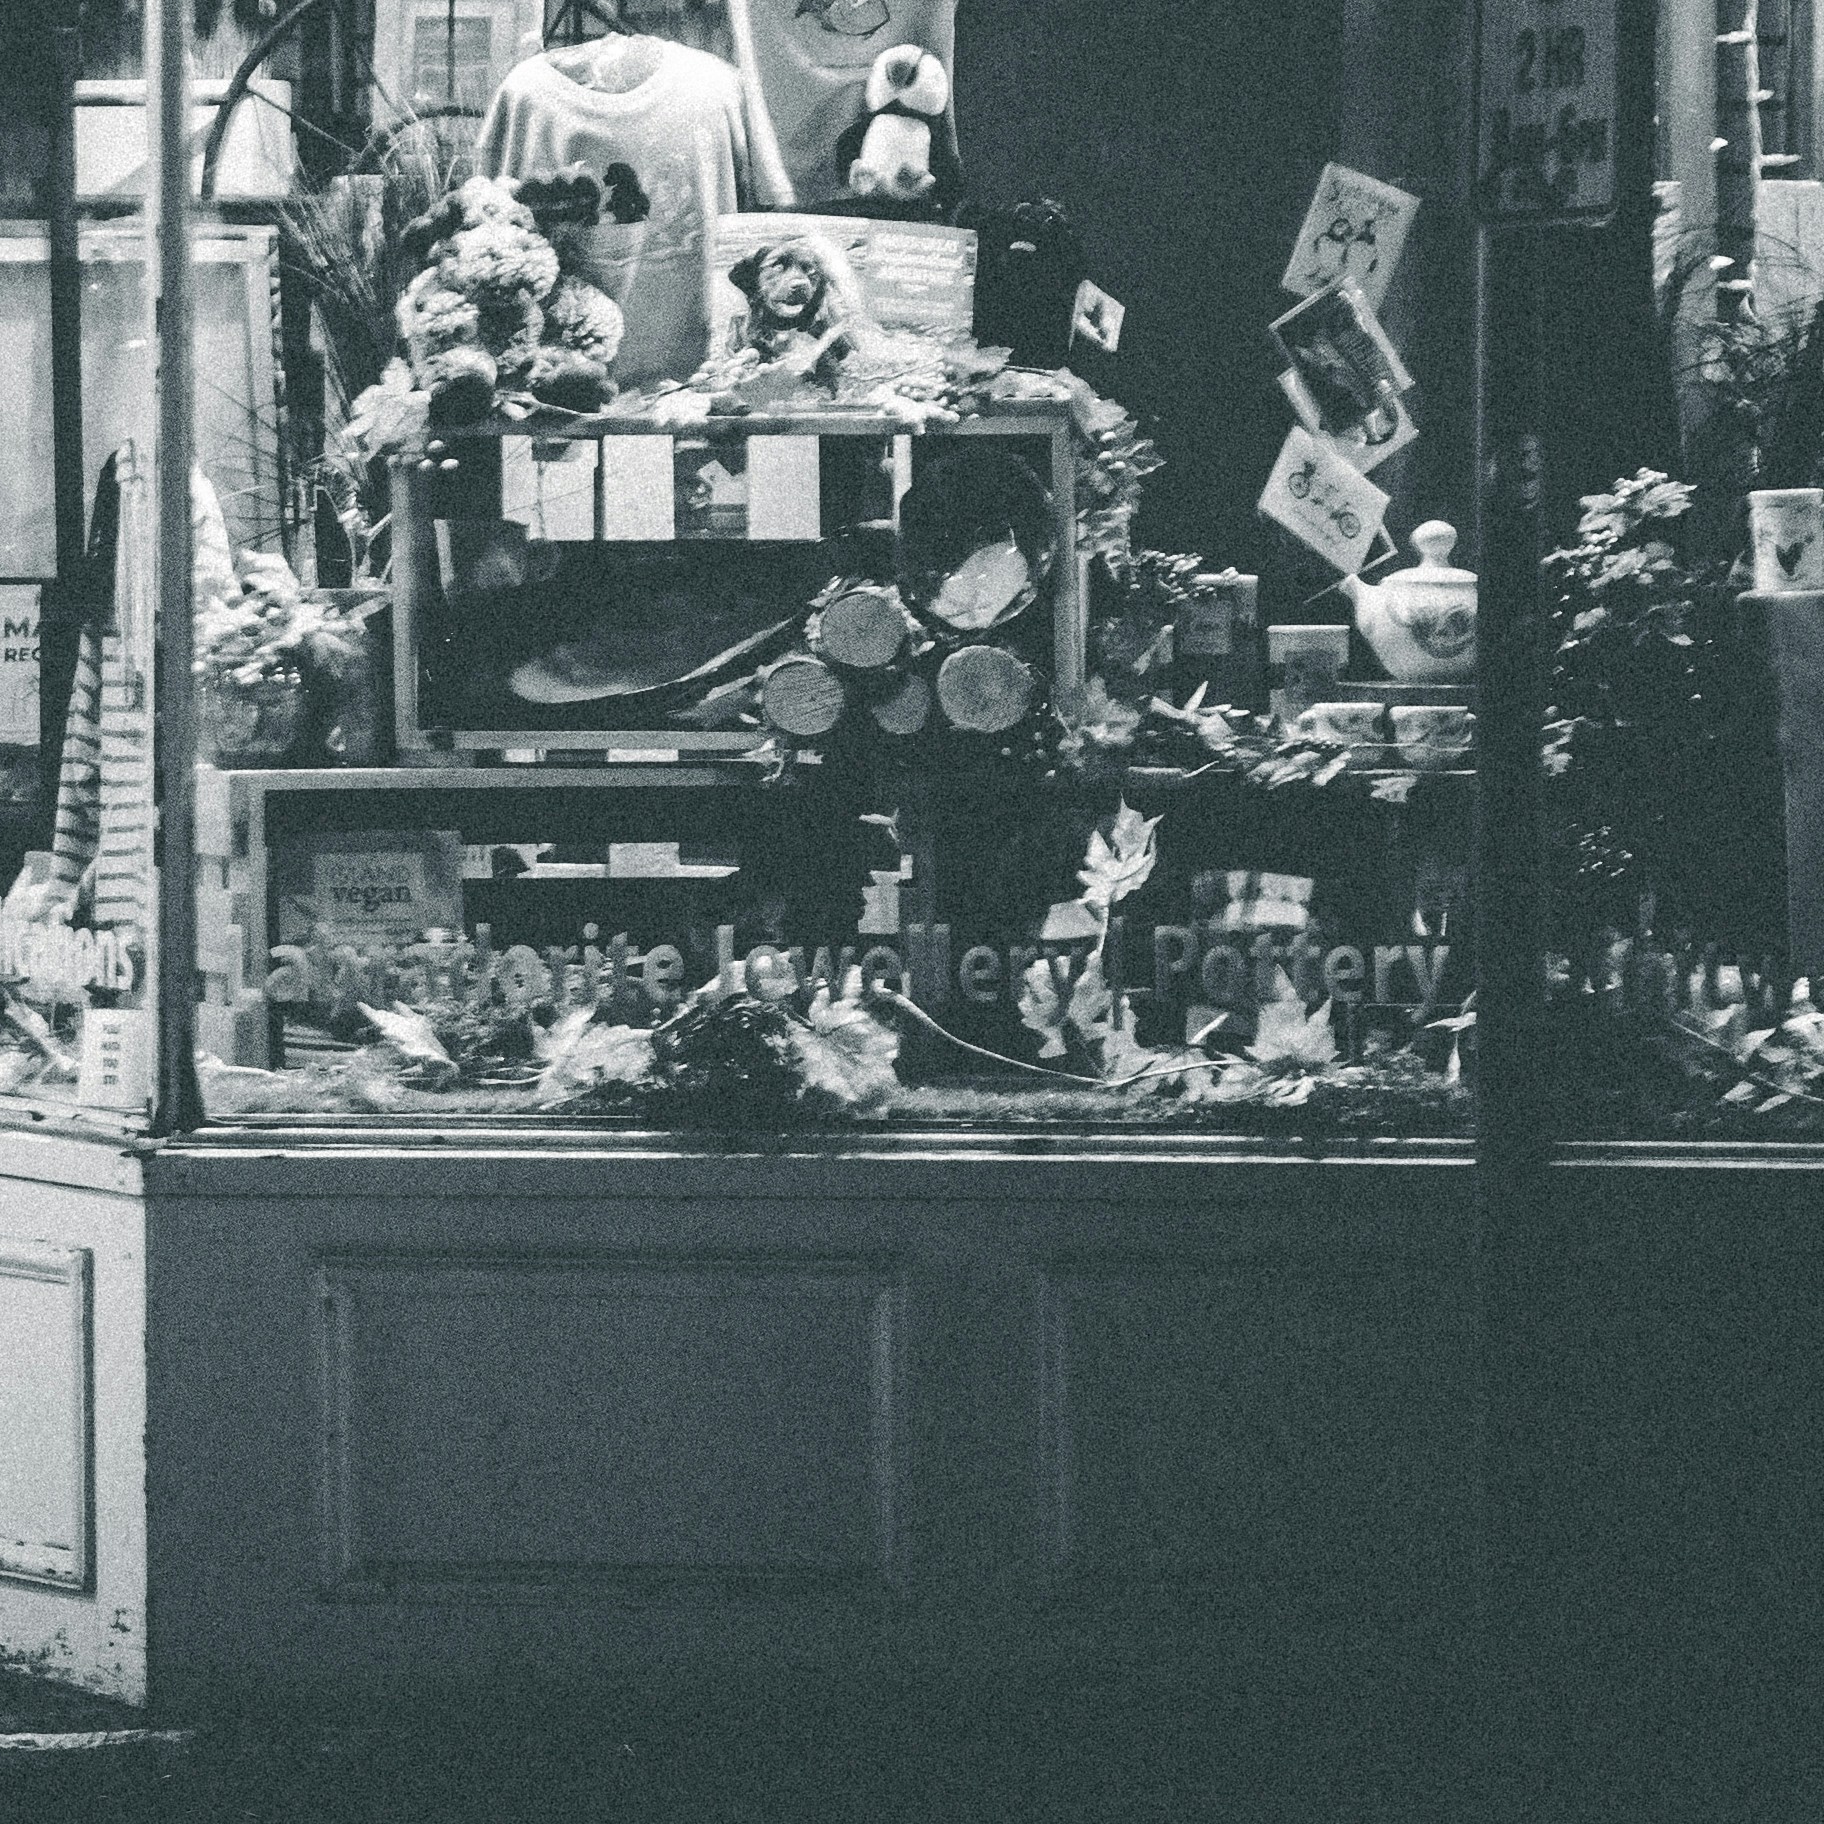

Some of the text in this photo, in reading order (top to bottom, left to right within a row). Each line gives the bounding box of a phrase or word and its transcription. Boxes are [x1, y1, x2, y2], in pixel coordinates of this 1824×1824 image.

[1513, 25, 1586, 93] 2 HR
[330, 885, 413, 913] vegan
[1153, 923, 1451, 1021] Pottery
